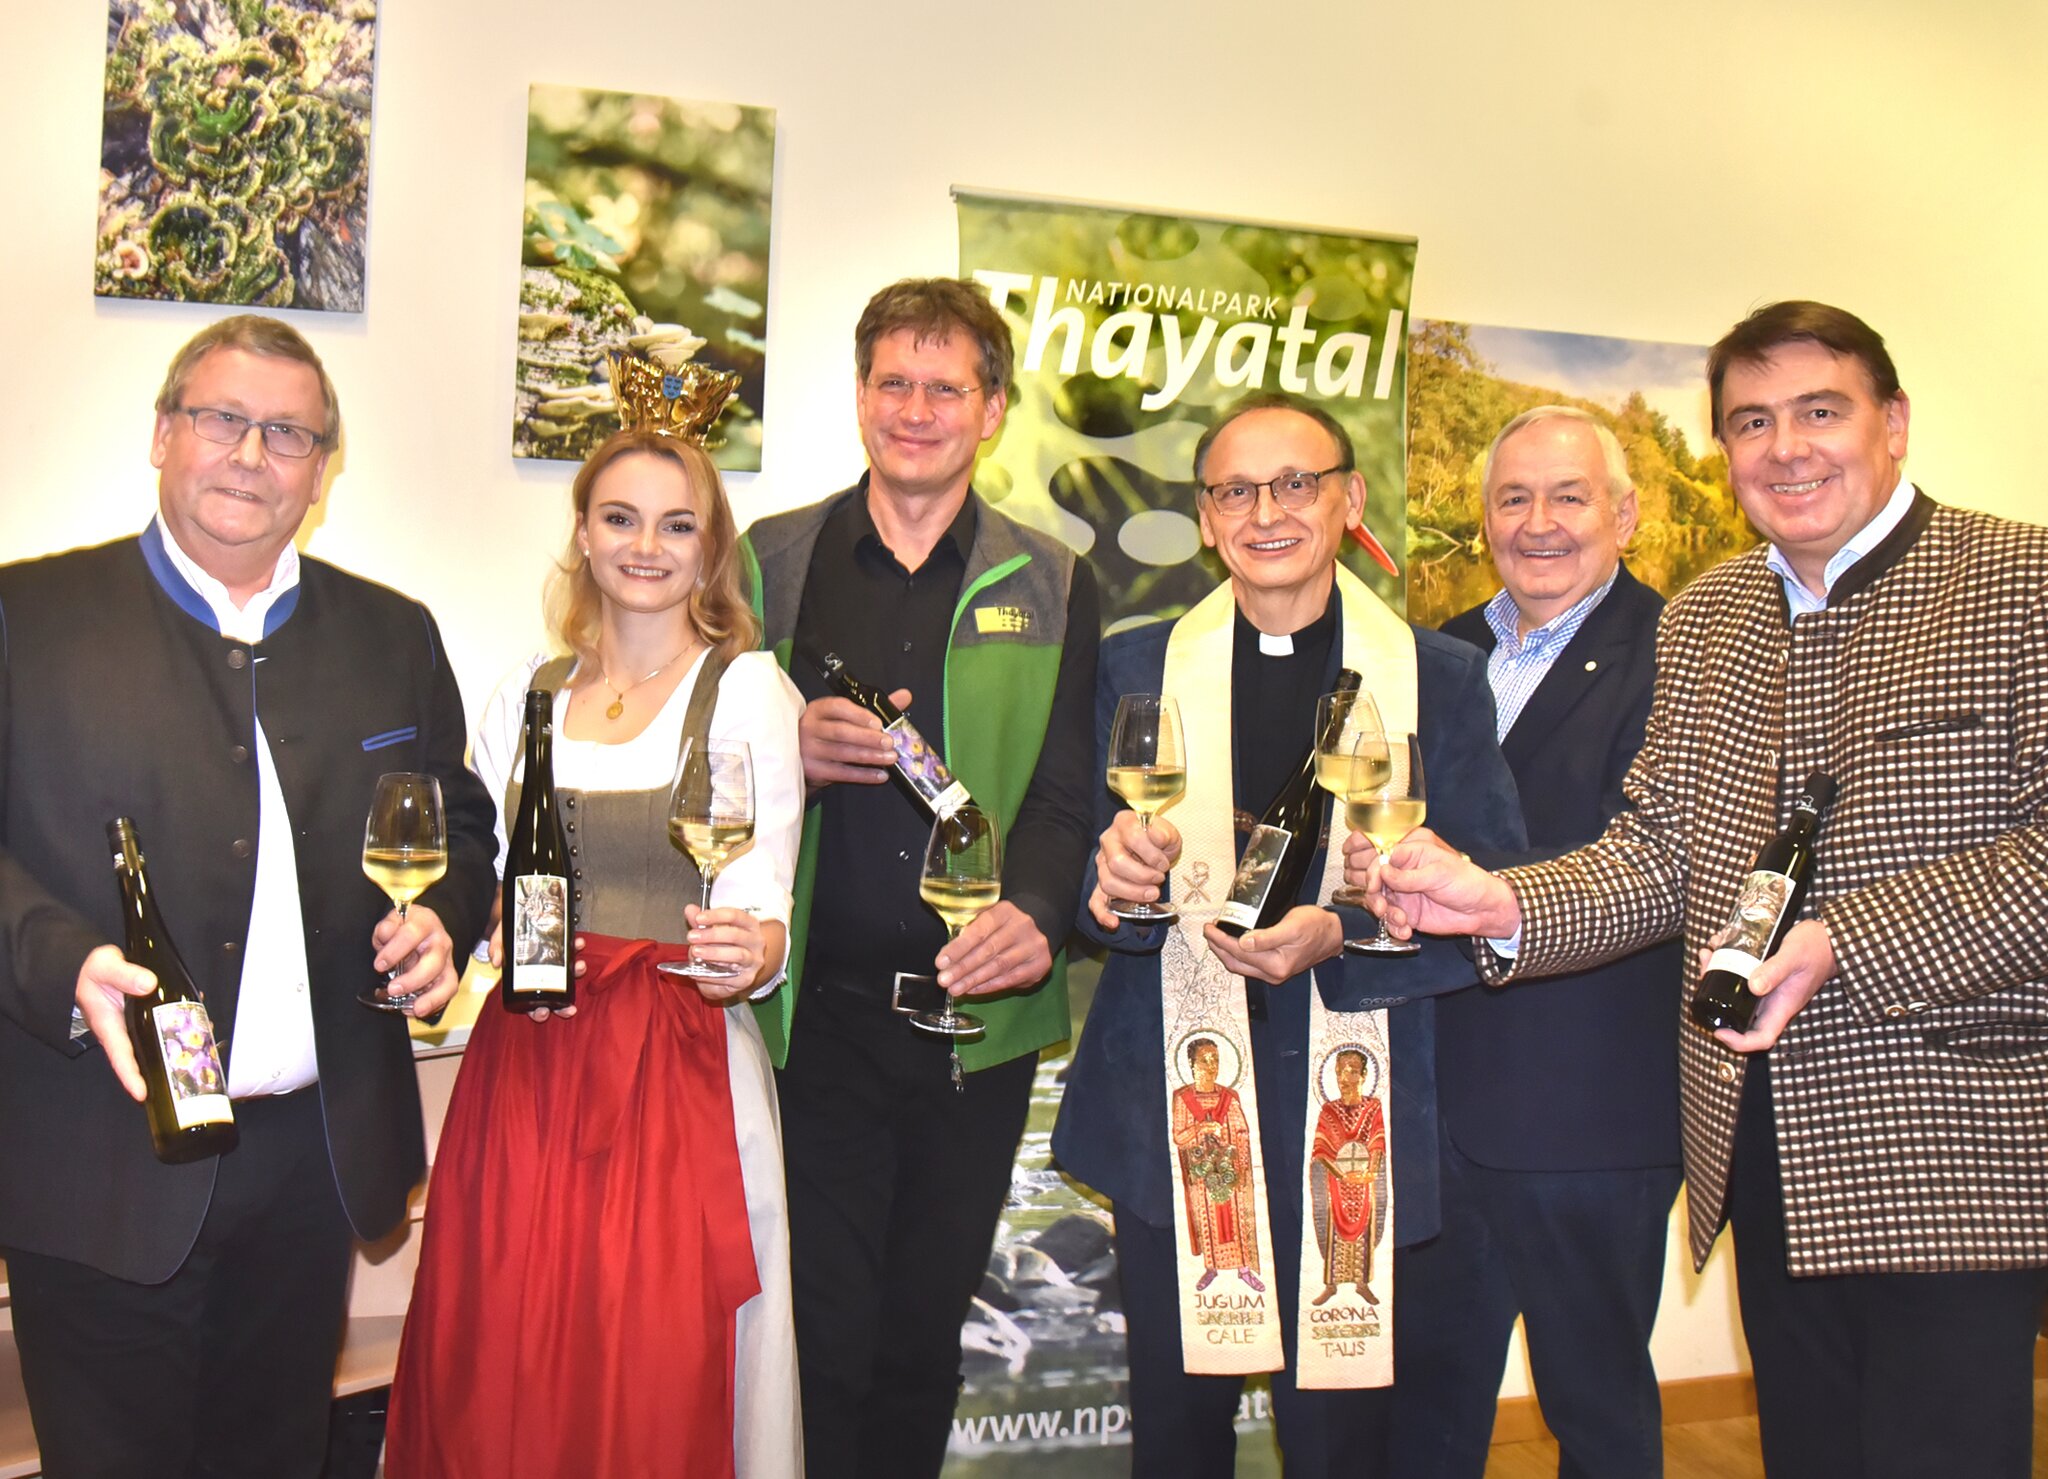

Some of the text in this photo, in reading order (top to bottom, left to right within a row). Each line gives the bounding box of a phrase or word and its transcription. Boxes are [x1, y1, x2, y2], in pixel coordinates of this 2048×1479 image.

[1066, 278, 1280, 320] NATIONALPARK
[972, 269, 1404, 411] Thayatal
[1194, 1293, 1265, 1310] JUGUM
[1310, 1306, 1379, 1323] CORONA
[1206, 1328, 1258, 1344] CALE
[952, 1404, 1132, 1445] www.np
